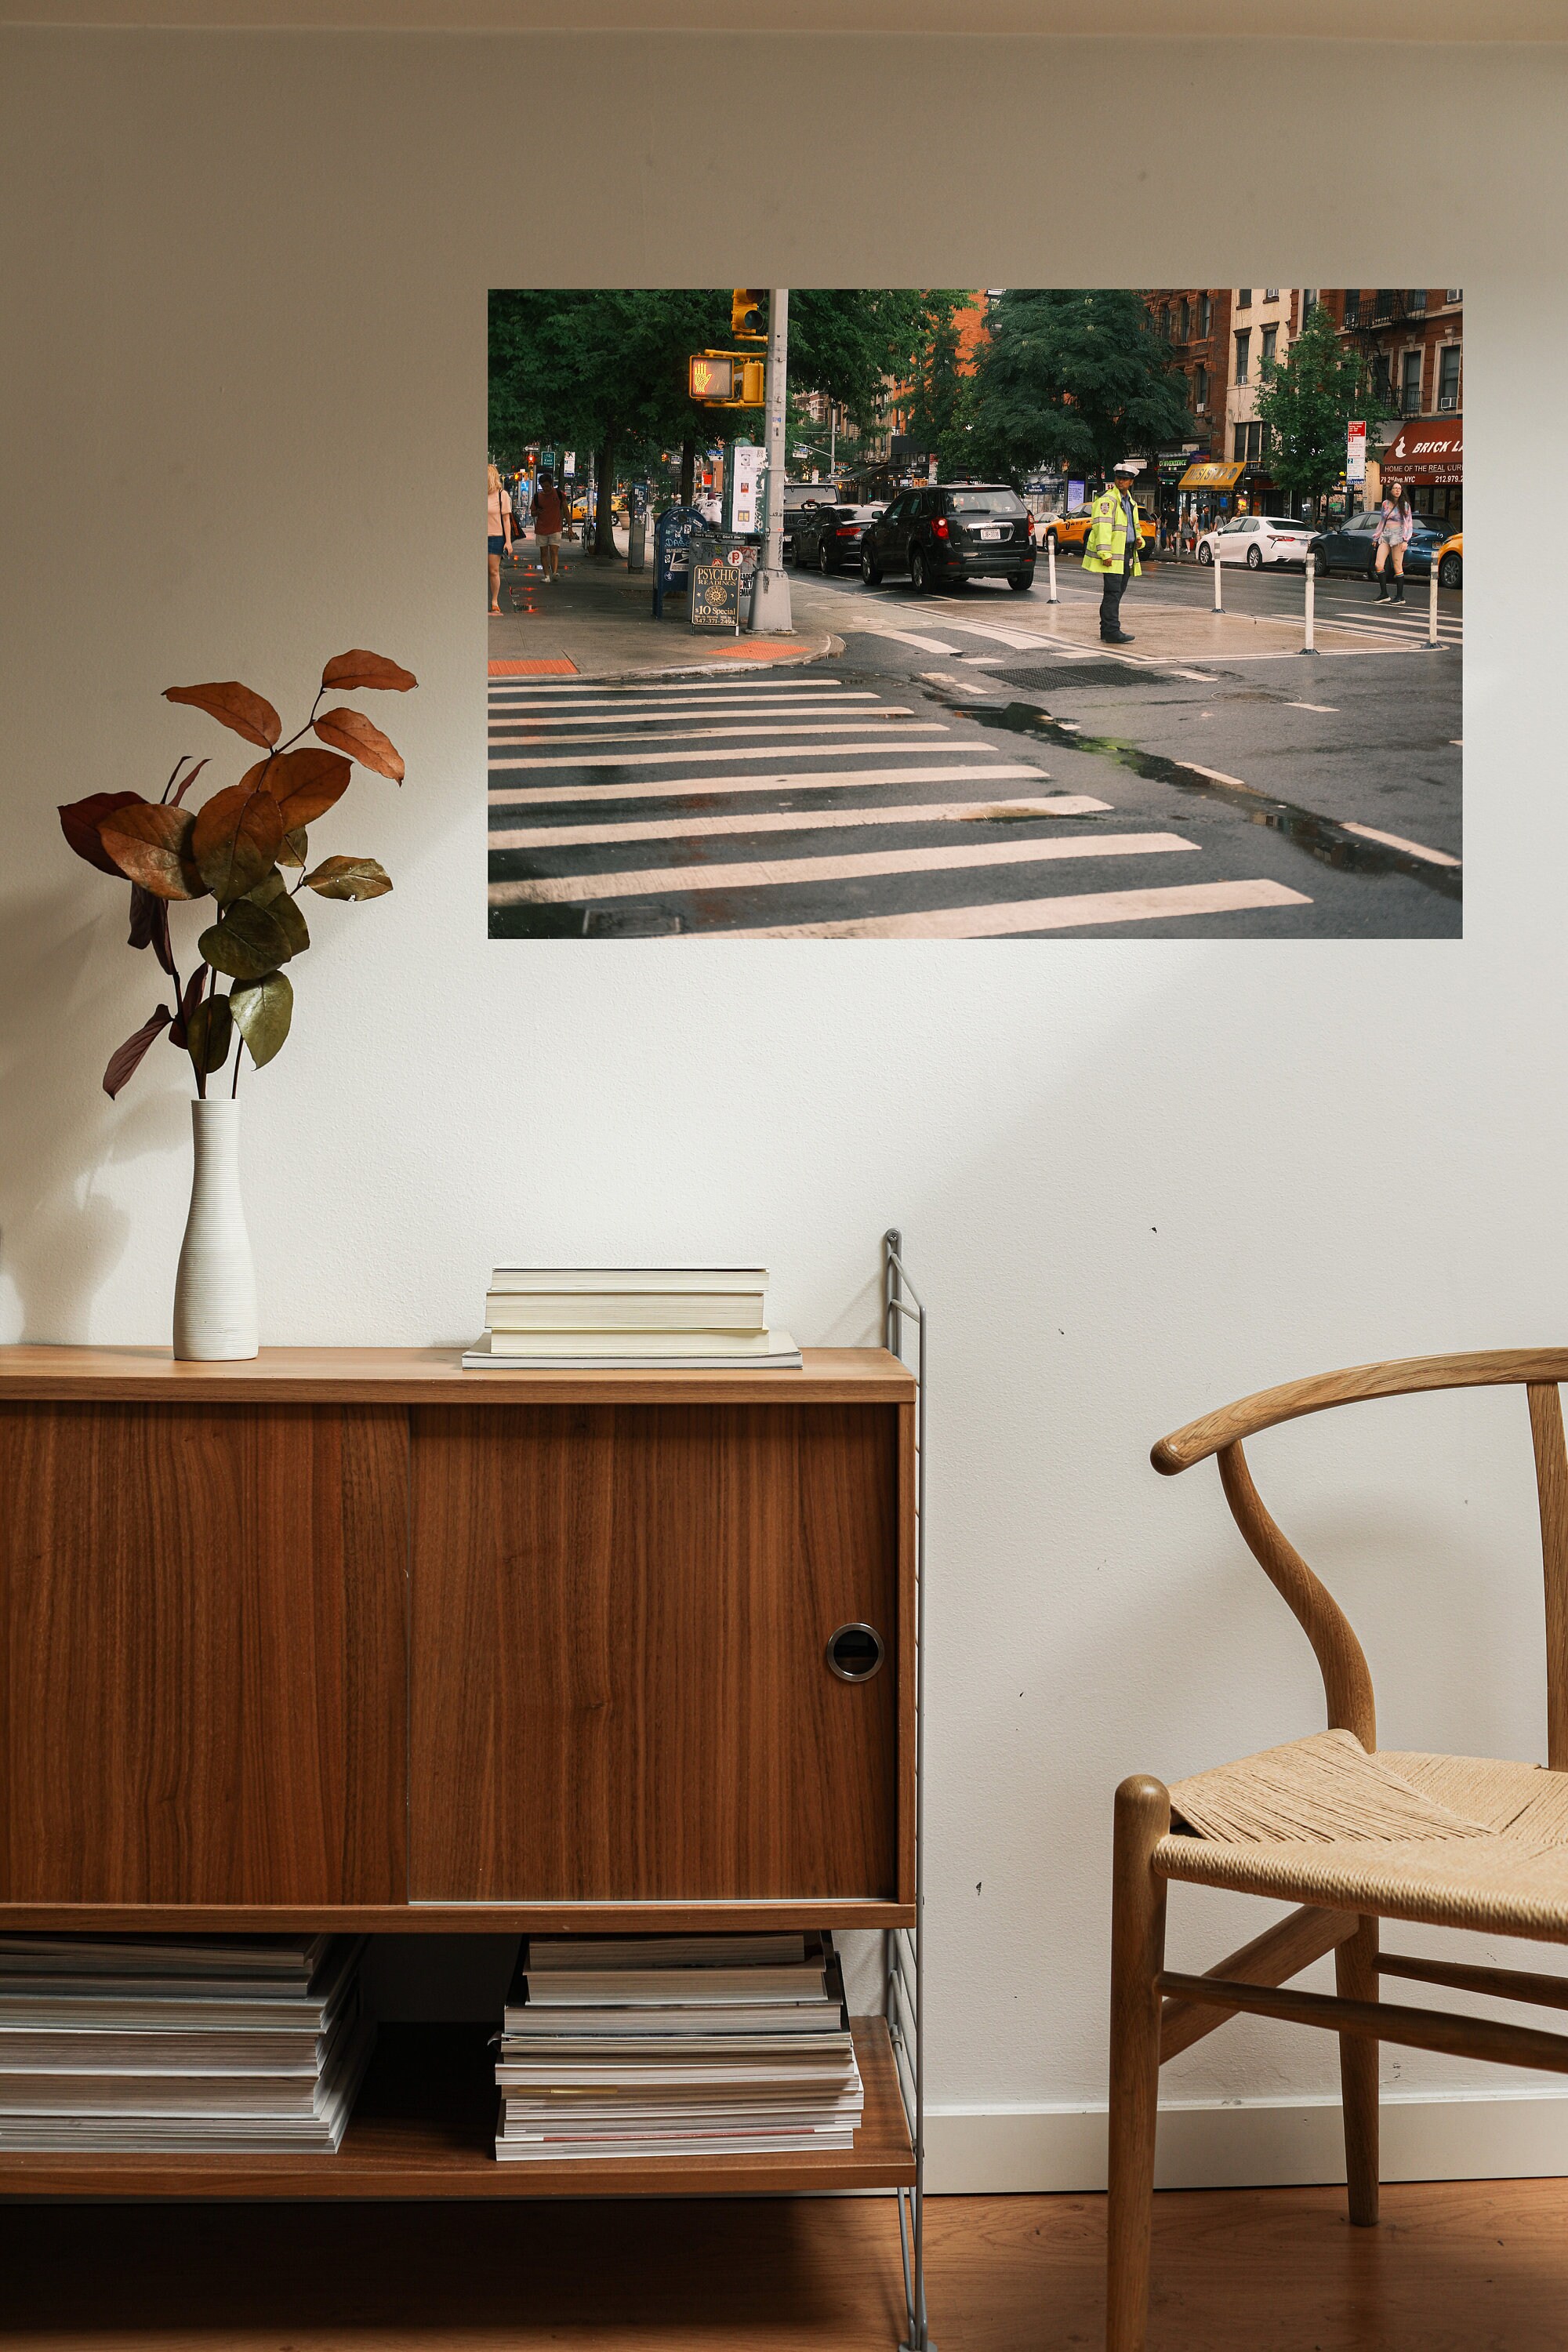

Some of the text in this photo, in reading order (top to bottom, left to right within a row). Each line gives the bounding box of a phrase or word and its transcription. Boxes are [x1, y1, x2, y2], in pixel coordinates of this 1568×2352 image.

[1412, 441, 1451, 453] BRICK
[1204, 467, 1228, 481] STOP
[698, 568, 737, 581] PSYCHIC
[695, 606, 735, 616] $10 Special
